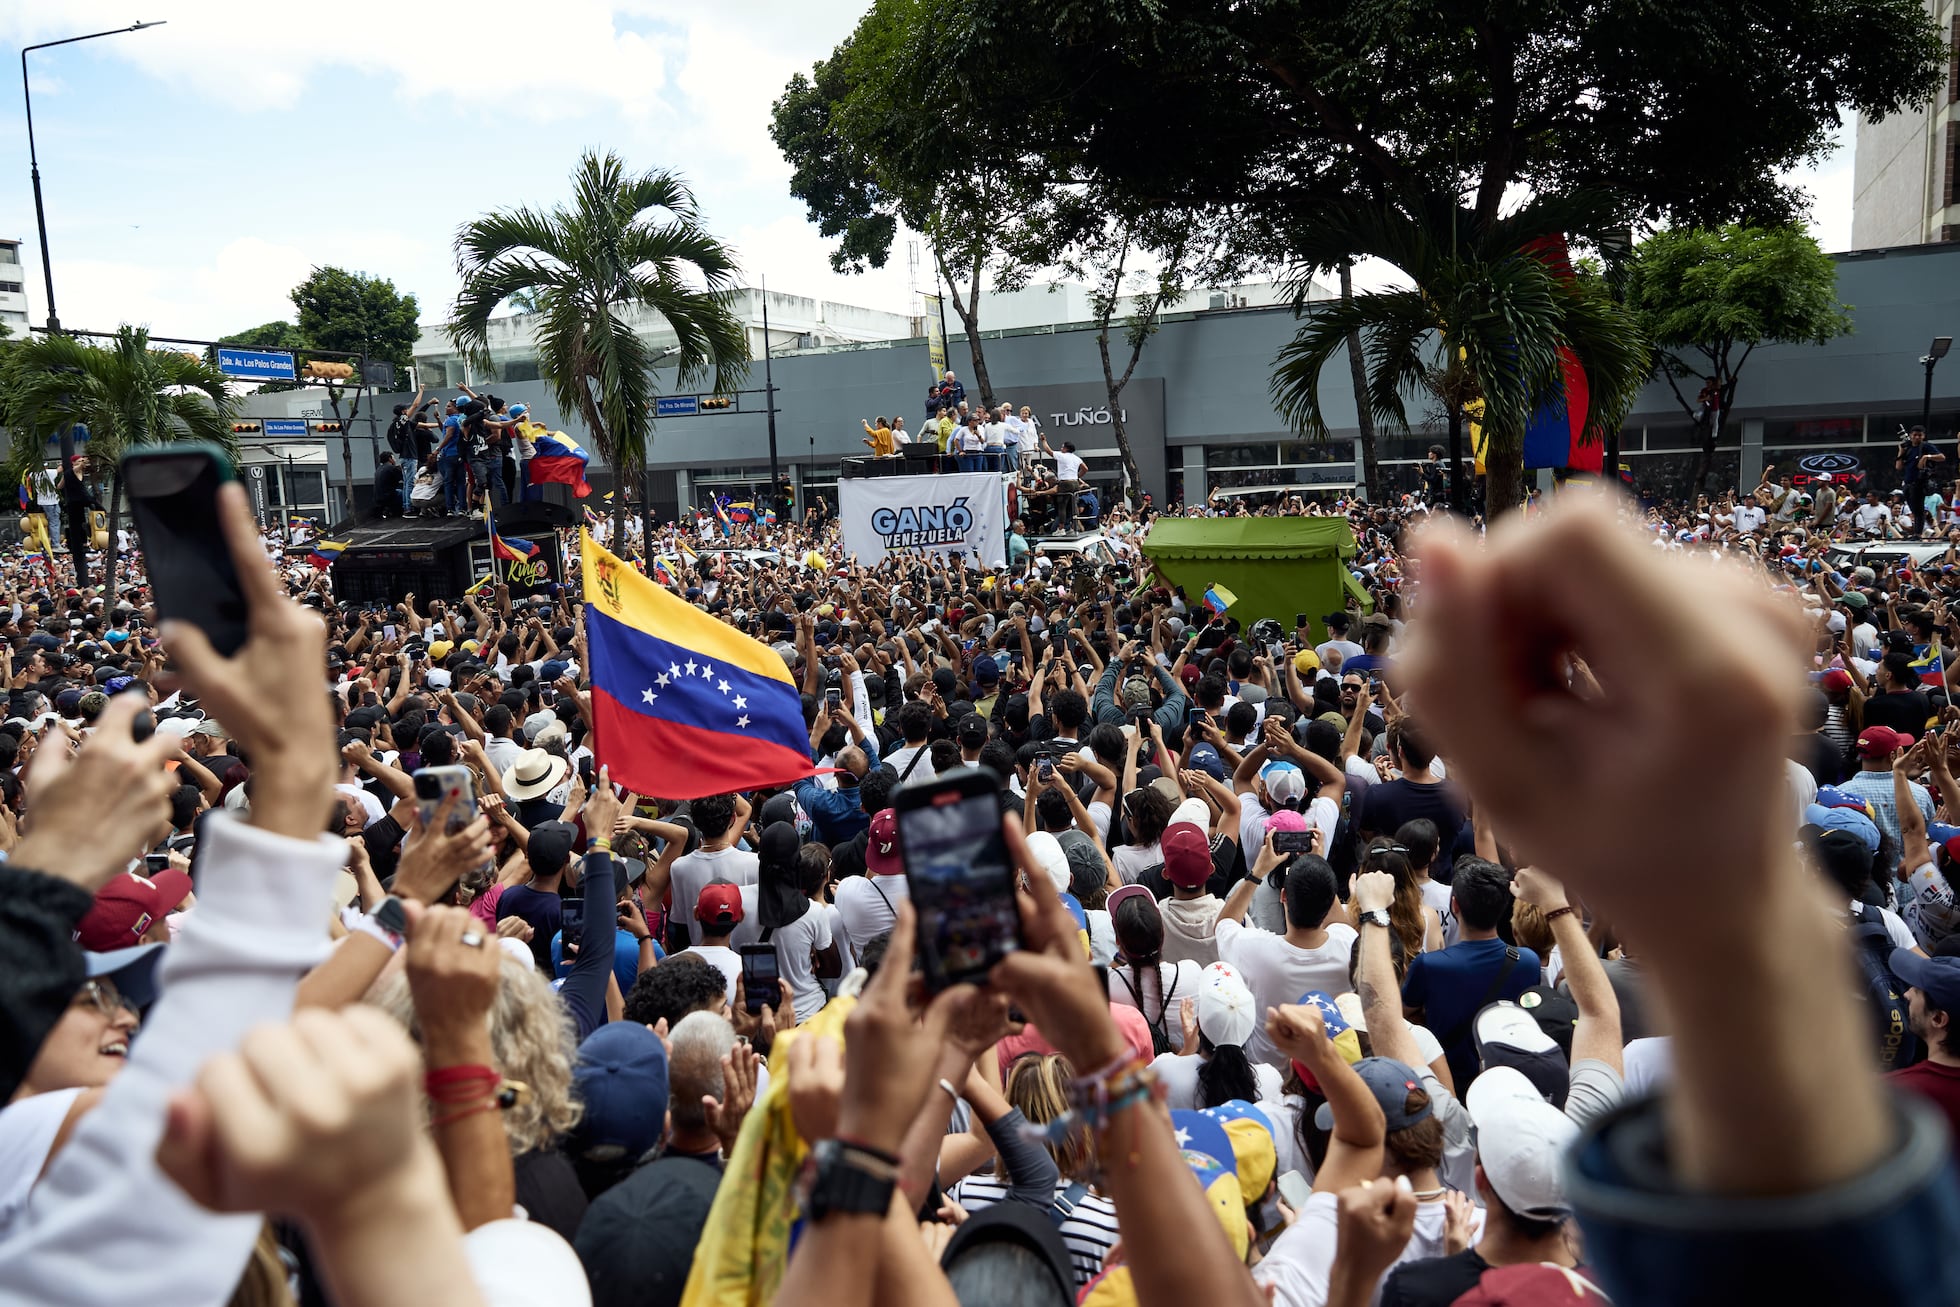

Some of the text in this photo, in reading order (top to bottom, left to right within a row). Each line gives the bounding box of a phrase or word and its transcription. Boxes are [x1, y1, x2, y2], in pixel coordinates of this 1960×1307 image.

[222, 356, 292, 371] 2da. Av. Los Palos Grandes
[871, 496, 973, 535] GANÓ
[884, 526, 964, 548] VENEZUELA
[1880, 1008, 1904, 1063] didas
